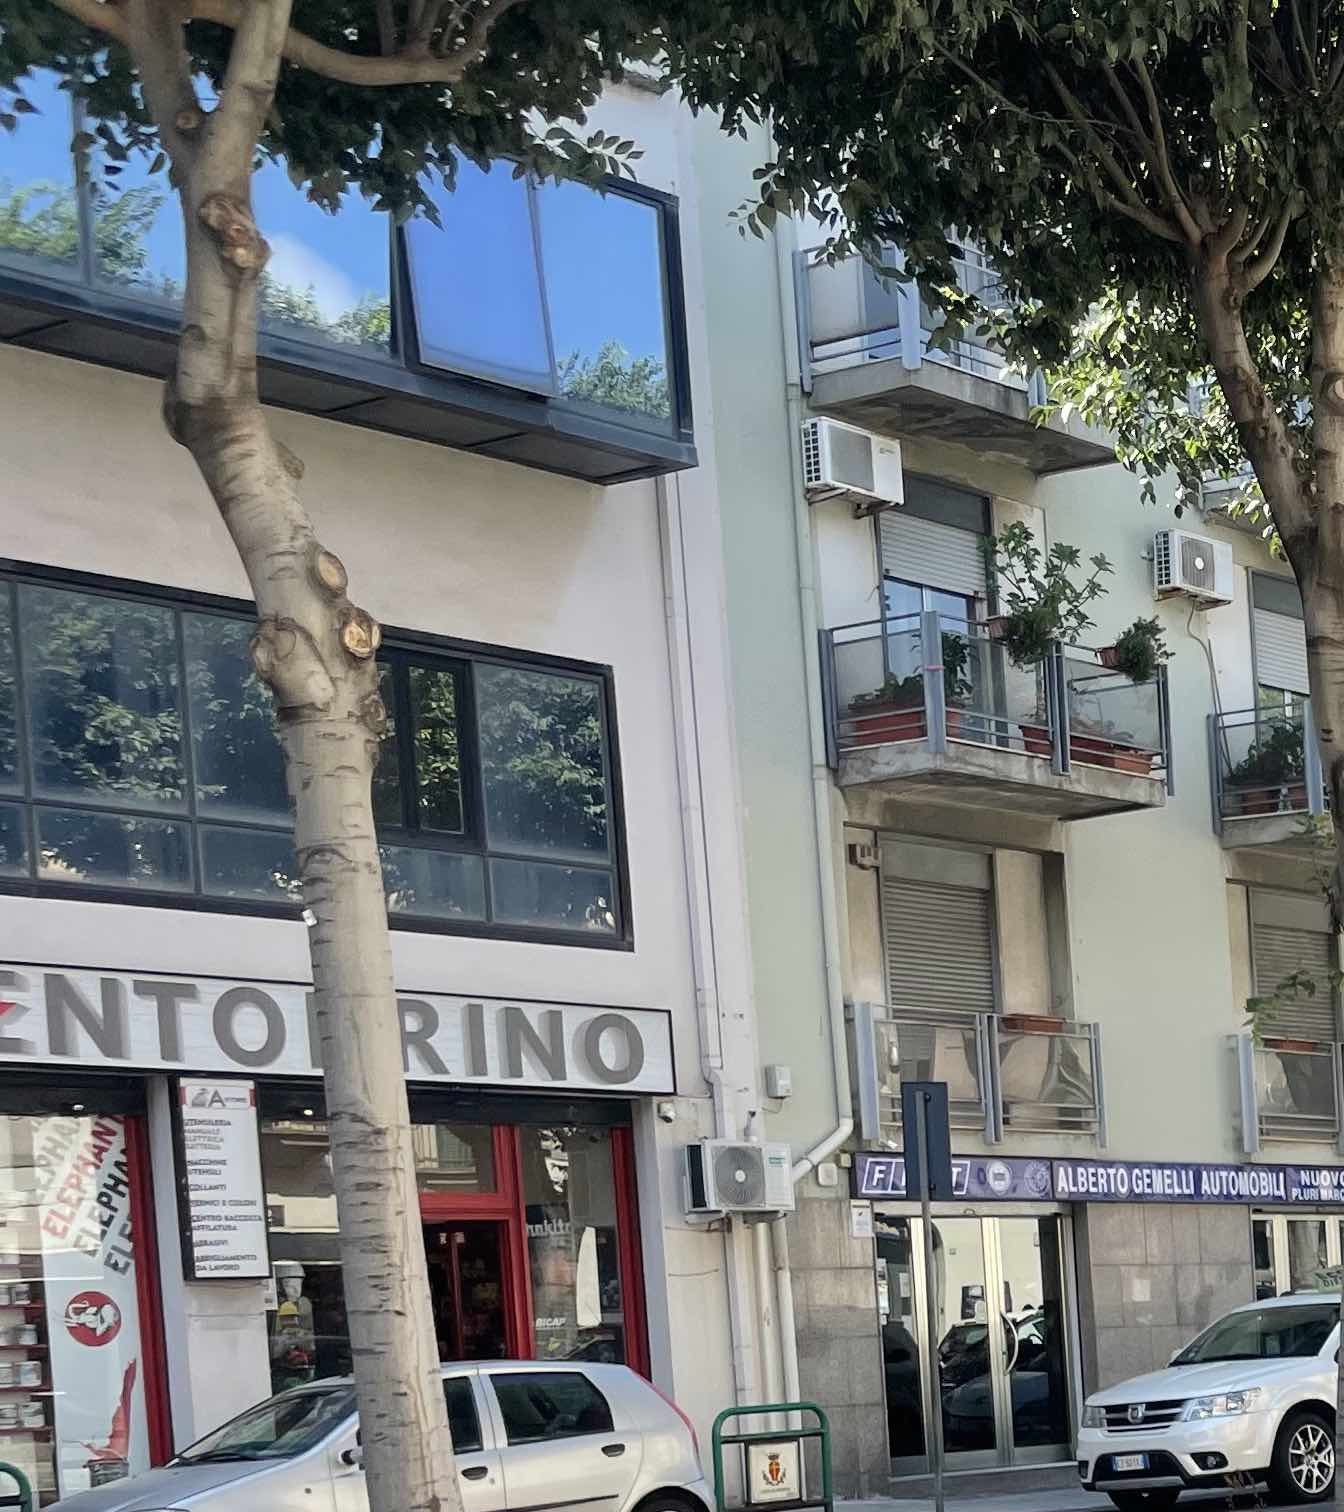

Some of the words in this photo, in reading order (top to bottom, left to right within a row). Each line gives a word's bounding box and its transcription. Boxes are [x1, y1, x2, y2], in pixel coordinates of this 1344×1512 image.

[0, 970, 645, 1085] NTORINO
[1057, 1166, 1130, 1193] ALBERTO
[1132, 1168, 1195, 1195] GEMELLI
[1201, 1170, 1285, 1199] AUTOMOBILI
